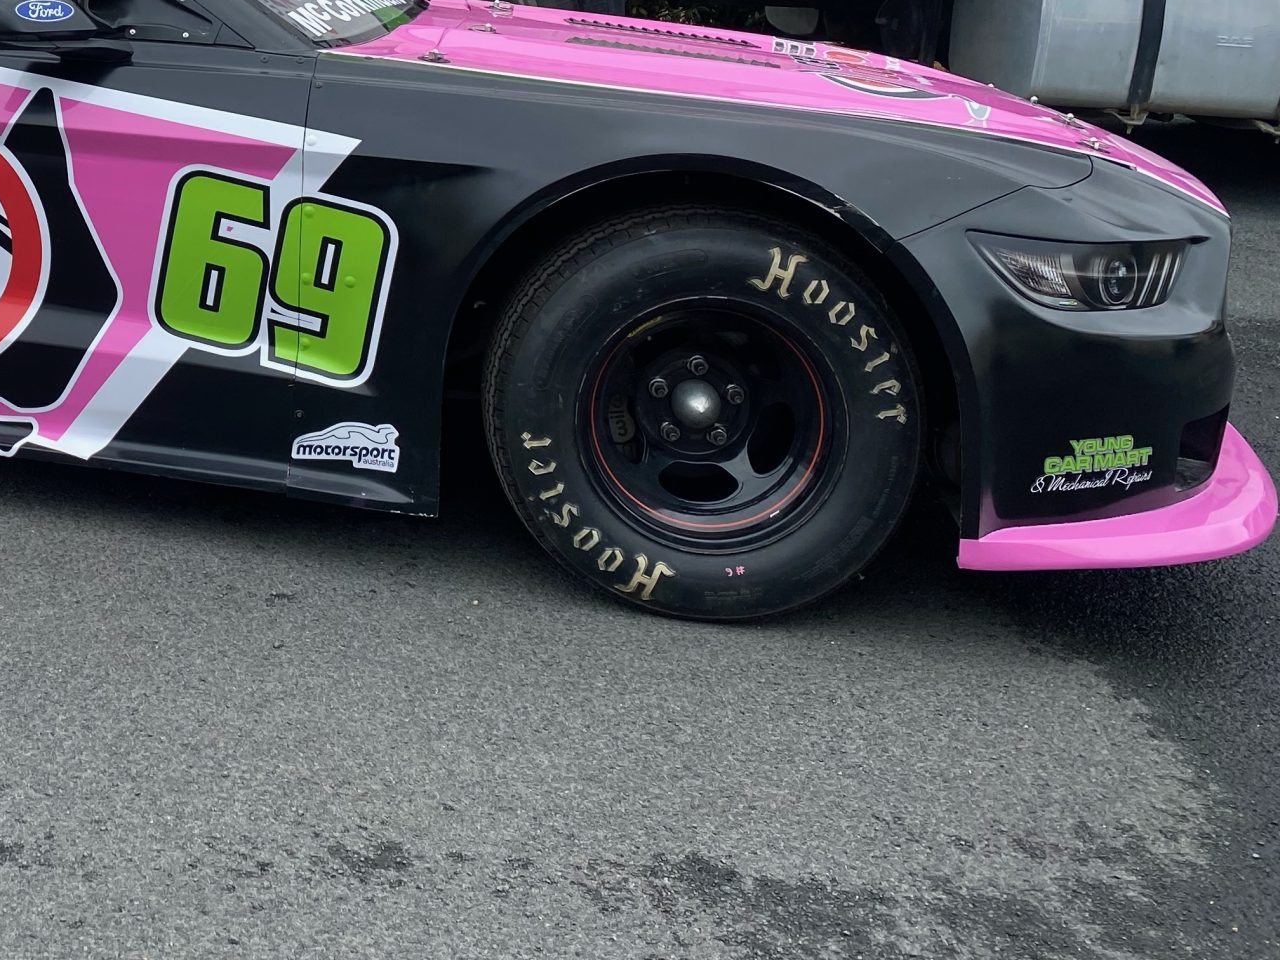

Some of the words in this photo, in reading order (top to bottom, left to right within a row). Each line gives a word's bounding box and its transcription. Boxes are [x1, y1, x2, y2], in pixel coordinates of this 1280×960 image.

[28, 1, 65, 18] Ford
[151, 167, 395, 384] 69
[747, 246, 908, 424] Hoosier
[296, 444, 396, 464] motorsport
[1070, 435, 1134, 455] YOUNG
[363, 458, 395, 468] australia
[1044, 455, 1092, 475] CAR
[1094, 447, 1153, 471] MART
[1044, 471, 1113, 491] Mechanical
[1112, 468, 1153, 490] Repairs
